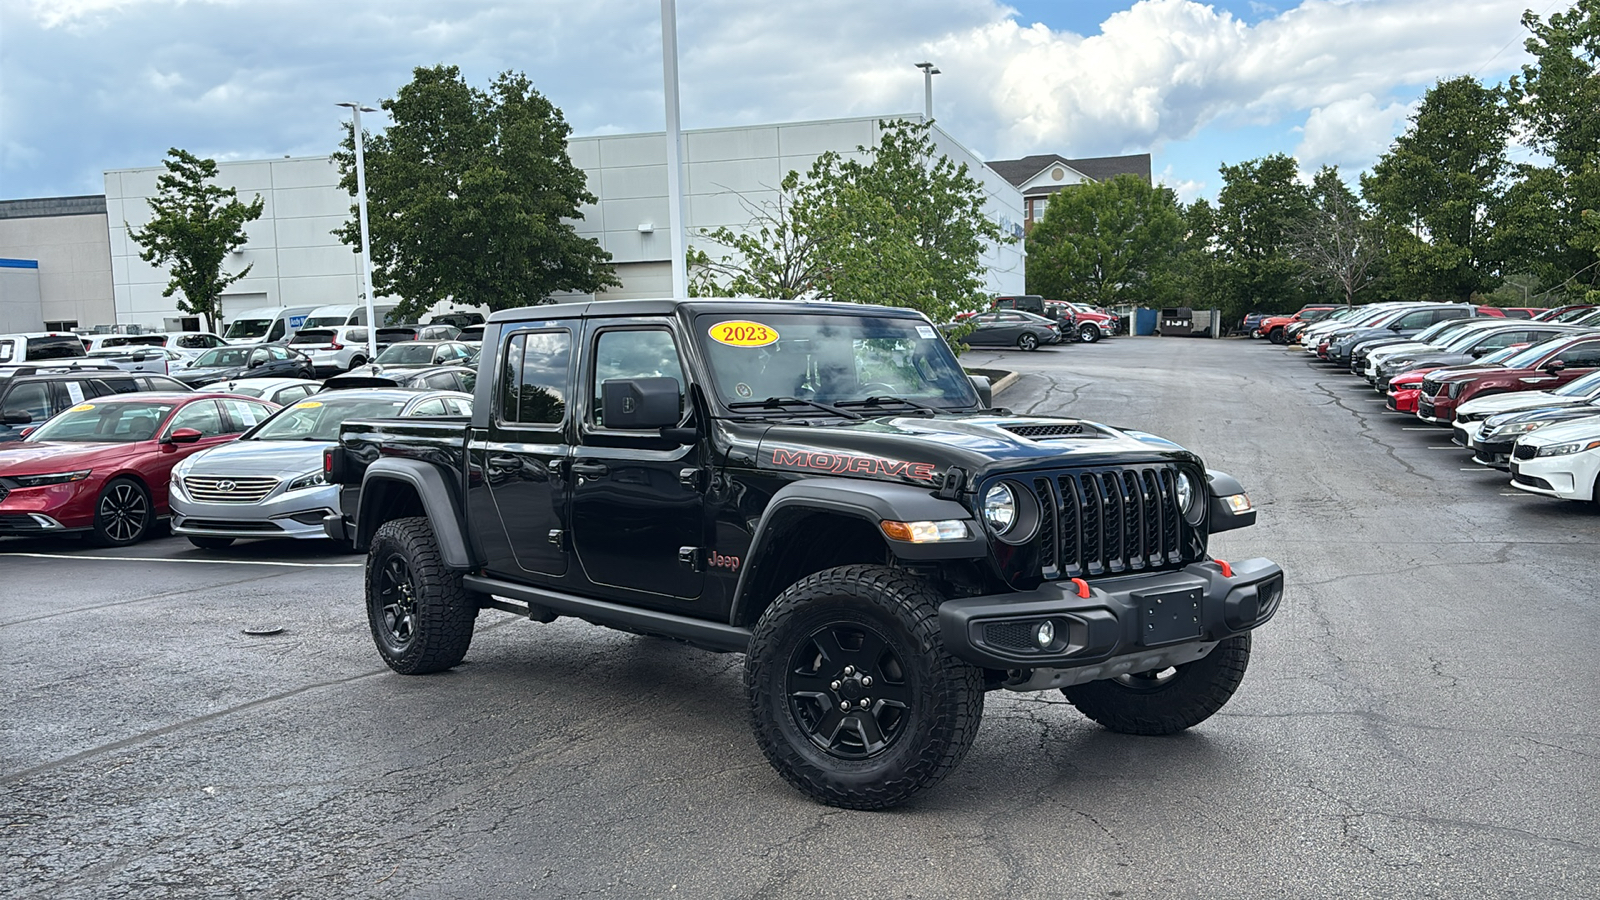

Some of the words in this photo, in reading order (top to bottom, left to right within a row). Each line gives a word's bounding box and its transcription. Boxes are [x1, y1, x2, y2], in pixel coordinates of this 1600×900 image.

[723, 326, 768, 341] 2023
[772, 449, 935, 480] MOJAVE
[708, 551, 740, 572] Jeep
